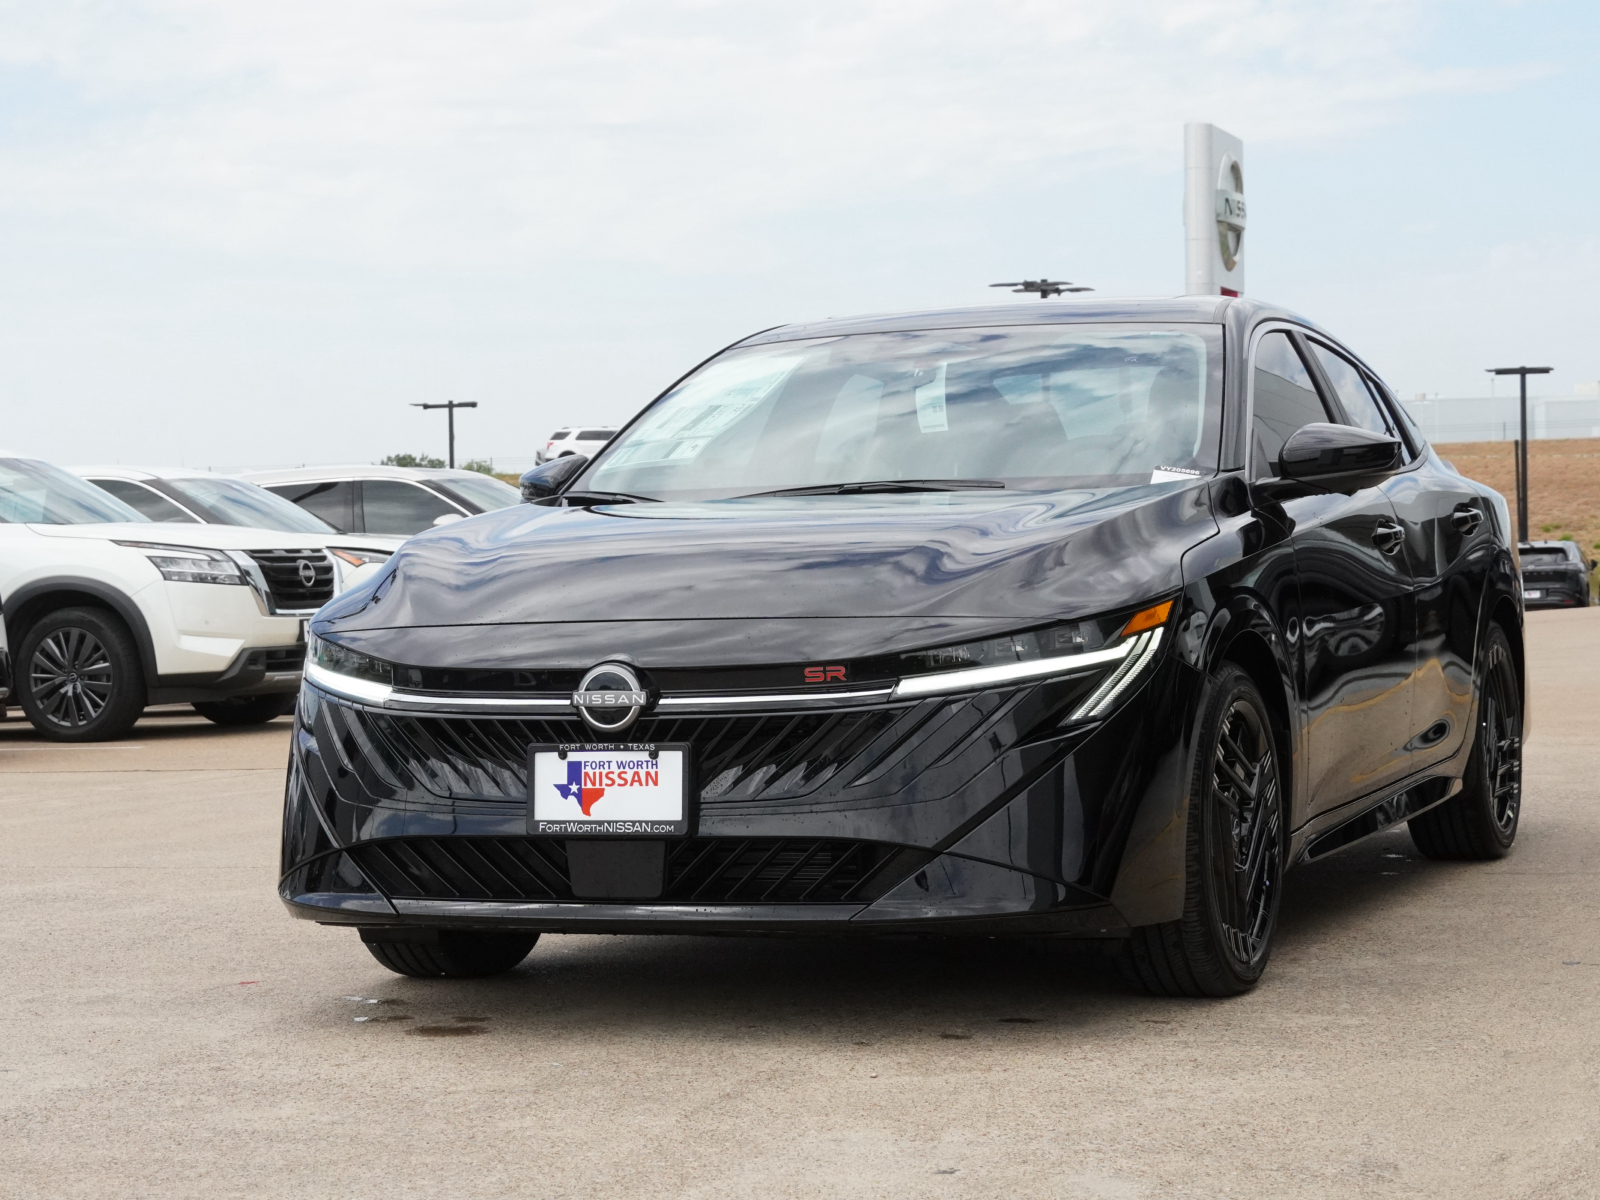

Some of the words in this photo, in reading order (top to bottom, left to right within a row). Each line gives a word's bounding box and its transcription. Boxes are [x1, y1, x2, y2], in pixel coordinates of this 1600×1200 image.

[803, 665, 847, 682] SR
[573, 693, 645, 705] NISSAN
[559, 743, 581, 751] FORT
[584, 743, 615, 751] WORTH
[627, 743, 656, 751] TEXAS
[583, 760, 613, 770] FORT
[616, 759, 659, 770] WORTH
[583, 770, 659, 787] NISSAN
